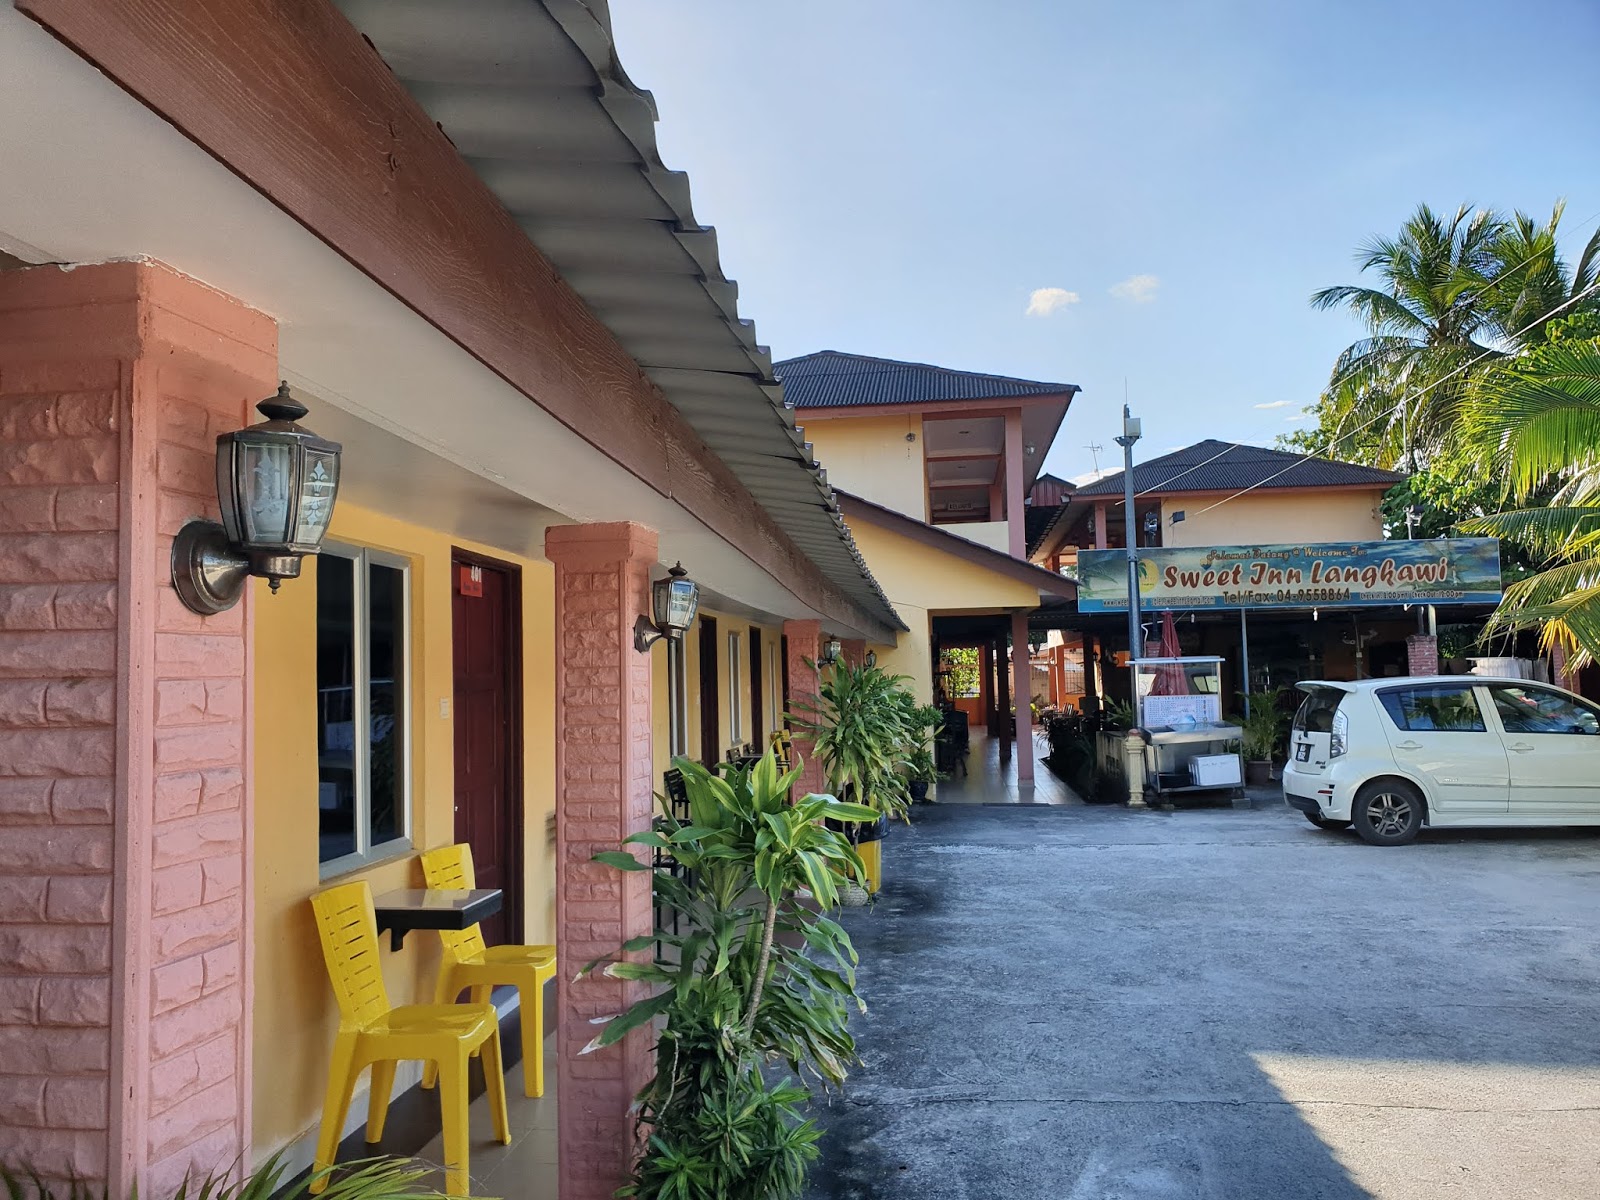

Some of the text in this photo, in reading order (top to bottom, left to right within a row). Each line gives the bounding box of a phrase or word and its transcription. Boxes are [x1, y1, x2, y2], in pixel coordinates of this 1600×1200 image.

[1207, 549, 1251, 561] Selamat
[1252, 548, 1290, 560] Datang
[1303, 546, 1348, 557] Welcome
[1164, 557, 1448, 589] Sweet Inn Langkawi
[1223, 587, 1350, 604] Tel/Fax: 04-9558864
